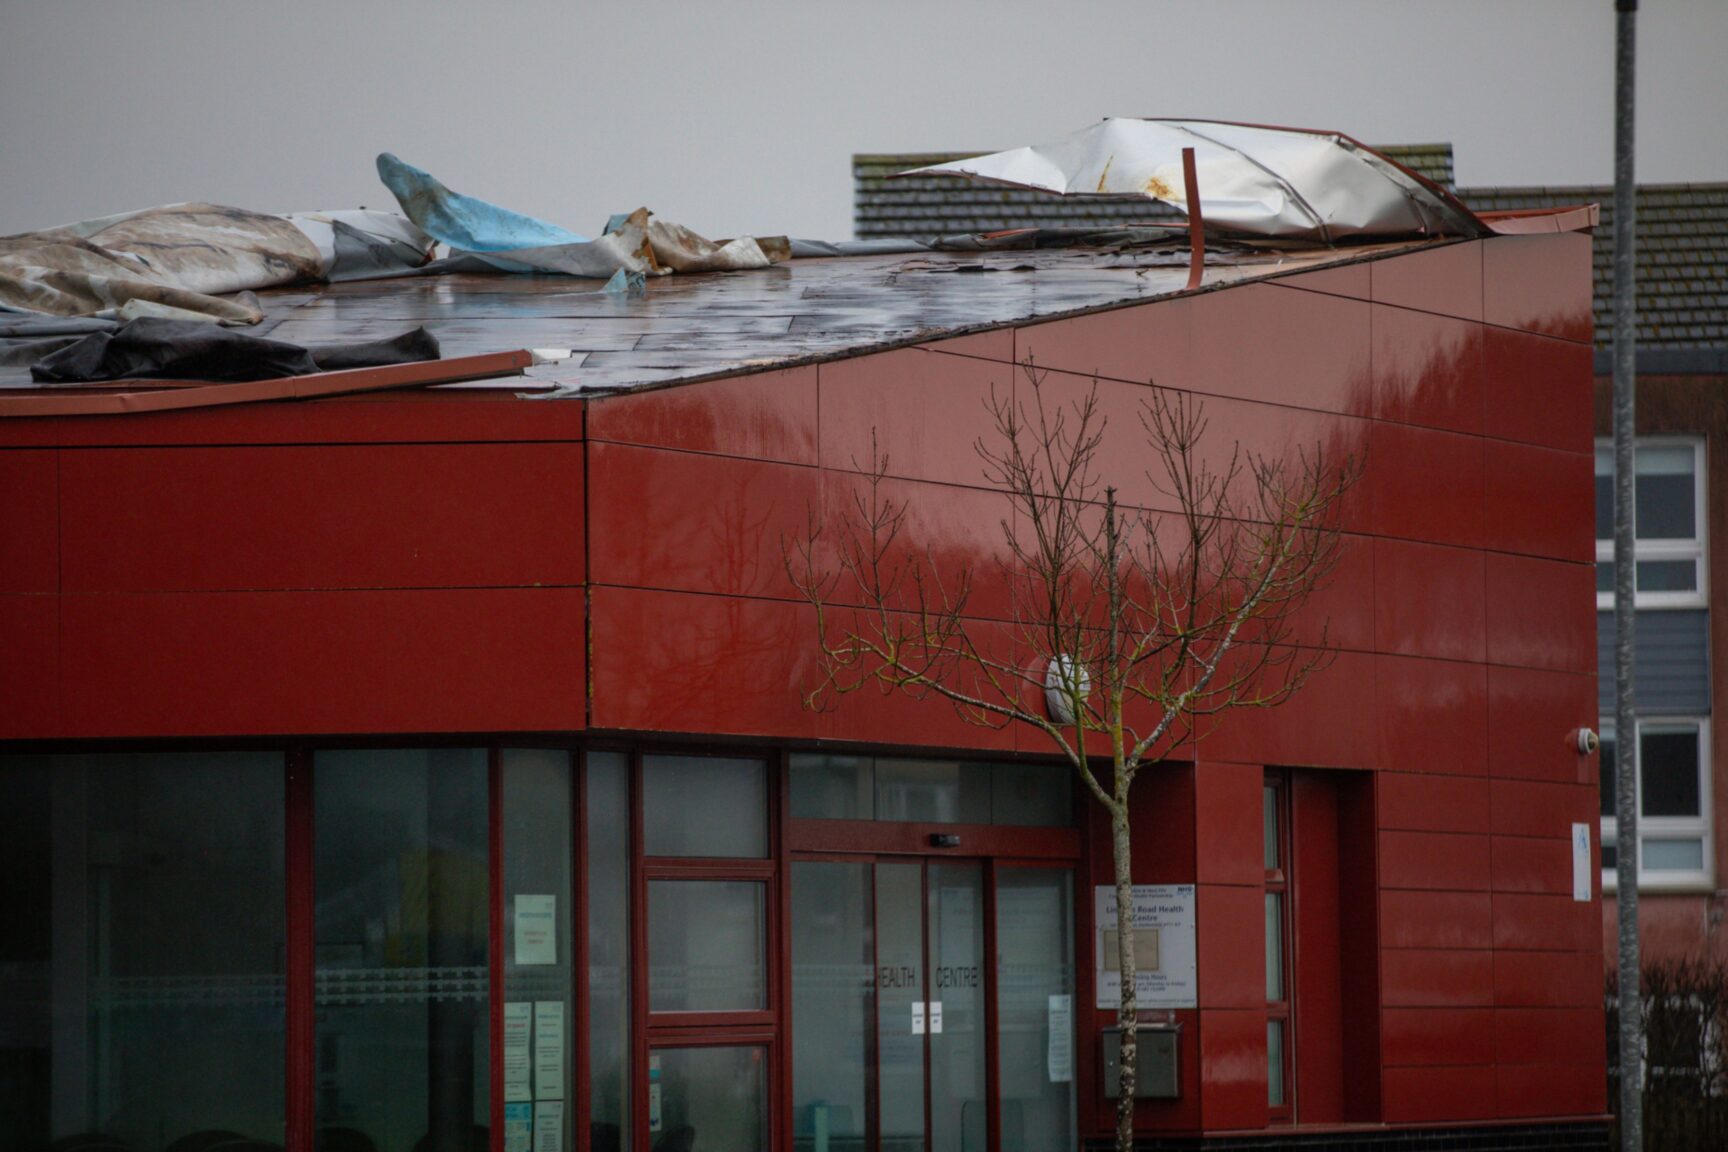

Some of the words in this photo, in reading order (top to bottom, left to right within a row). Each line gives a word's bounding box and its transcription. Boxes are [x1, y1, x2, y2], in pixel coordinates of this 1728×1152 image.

[1137, 905, 1157, 913] Road
[1158, 904, 1184, 913] Health
[935, 966, 978, 988] CENTRE
